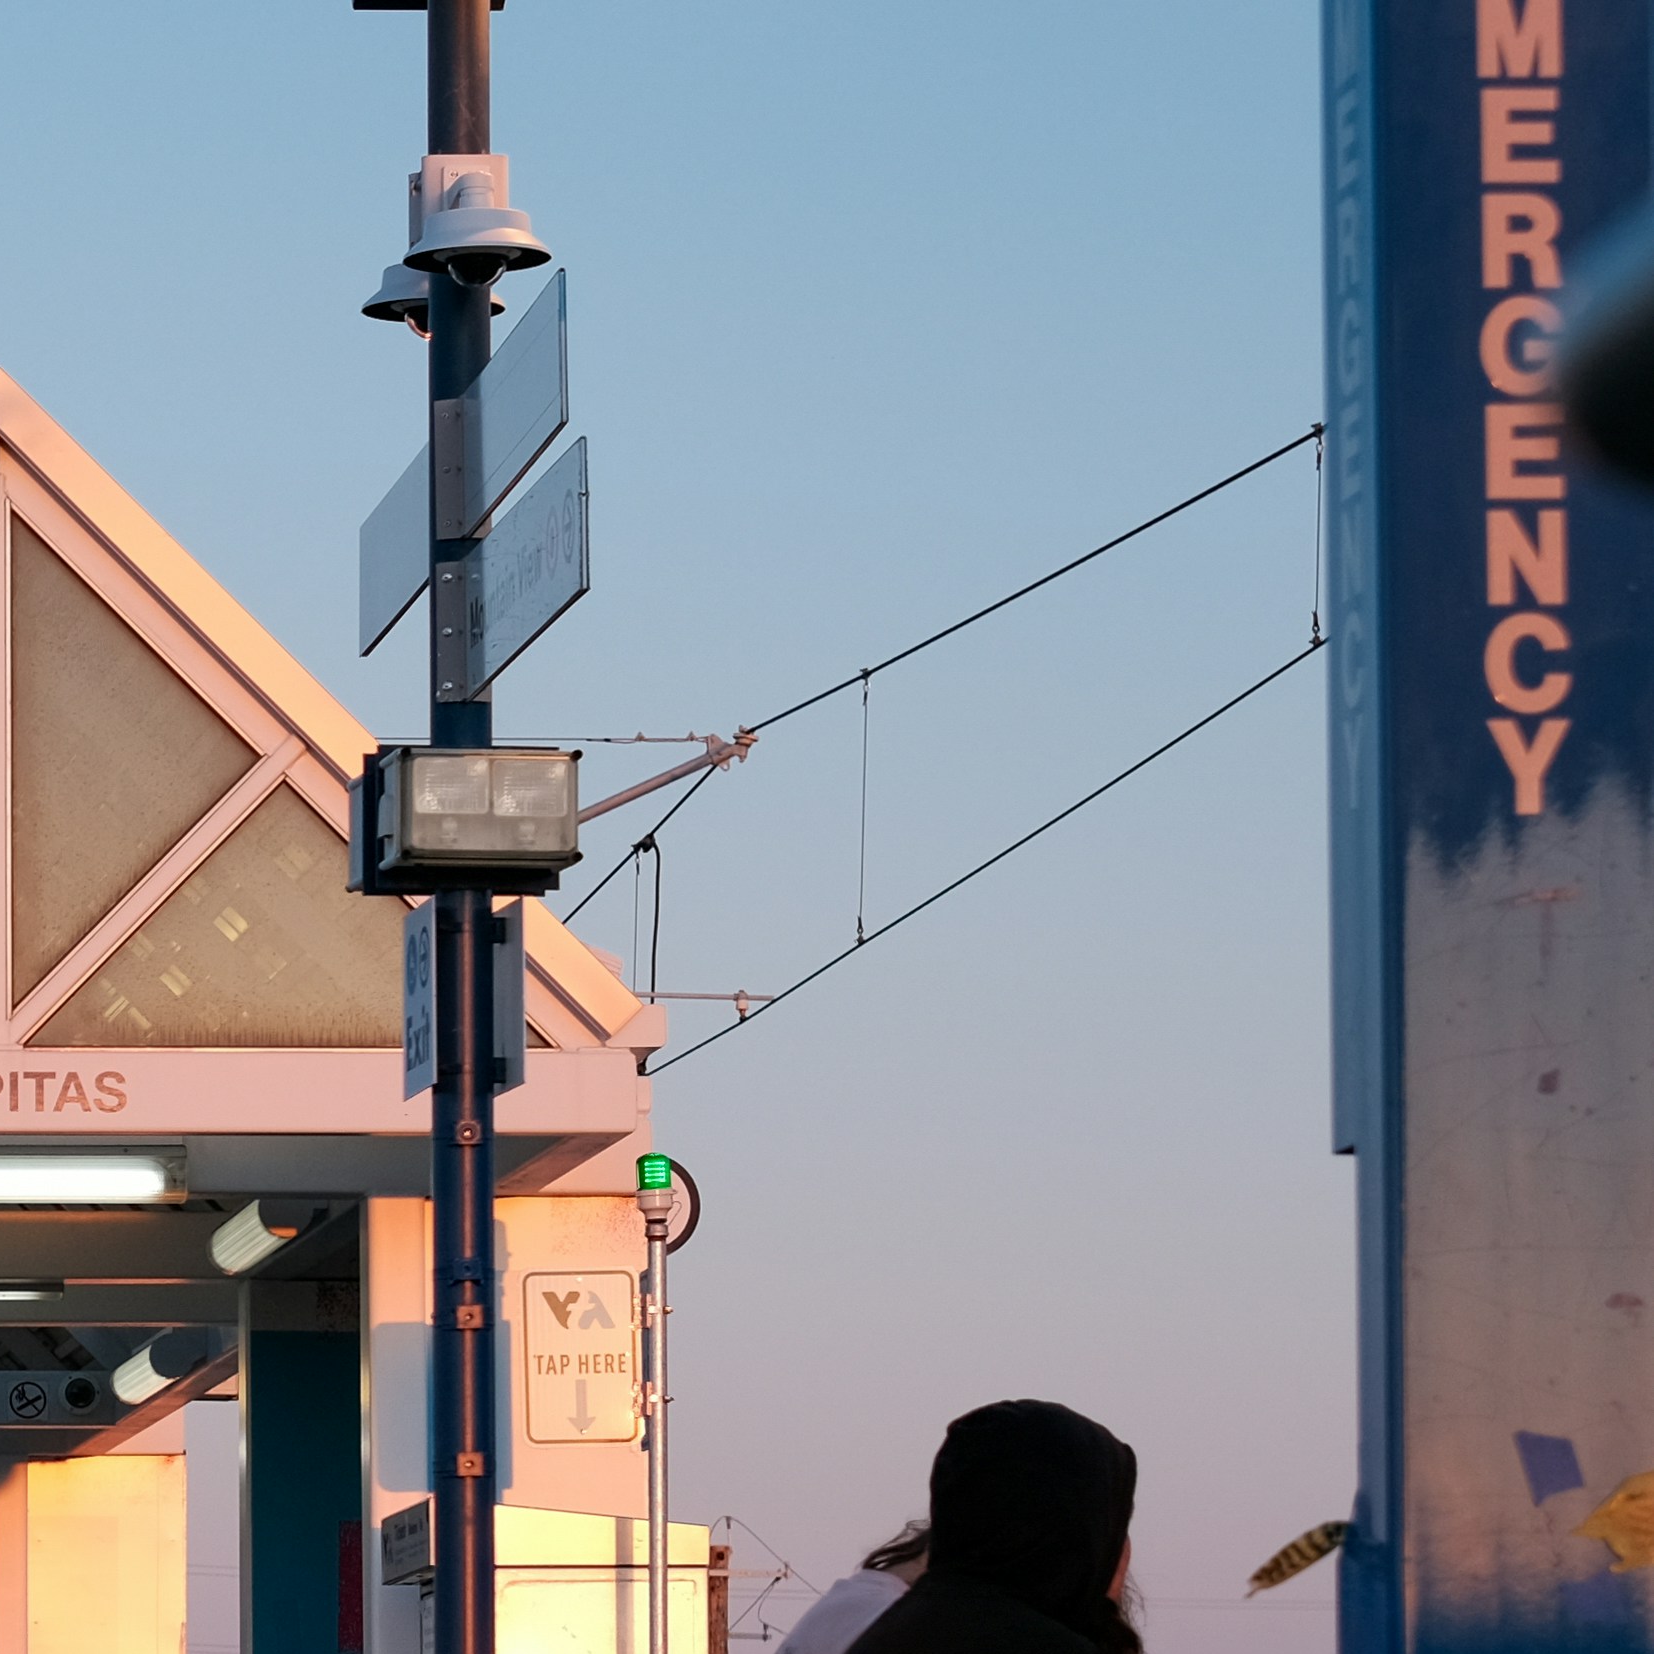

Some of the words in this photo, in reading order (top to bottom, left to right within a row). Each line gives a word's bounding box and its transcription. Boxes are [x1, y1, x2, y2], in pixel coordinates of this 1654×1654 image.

[1476, 0, 1573, 816] MERGENCY
[407, 1004, 430, 1072] Exit
[534, 1355, 570, 1375] TAP
[578, 1353, 627, 1374] HERE
